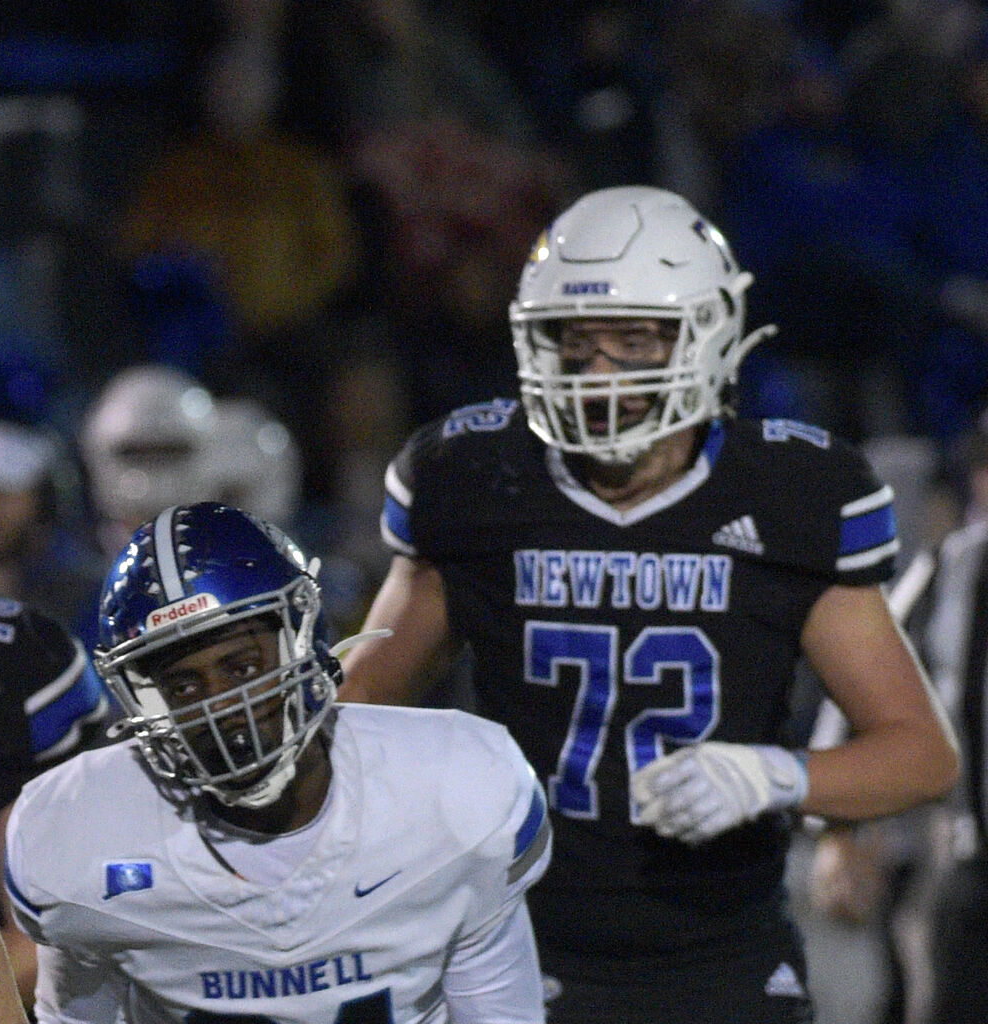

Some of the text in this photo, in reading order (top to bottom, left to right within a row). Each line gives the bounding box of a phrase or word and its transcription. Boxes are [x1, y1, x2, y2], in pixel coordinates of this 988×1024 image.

[513, 550, 733, 612] NEWTOWN
[151, 596, 208, 627] Rddell
[524, 620, 722, 826] 72
[199, 953, 372, 1000] BUNNELL
